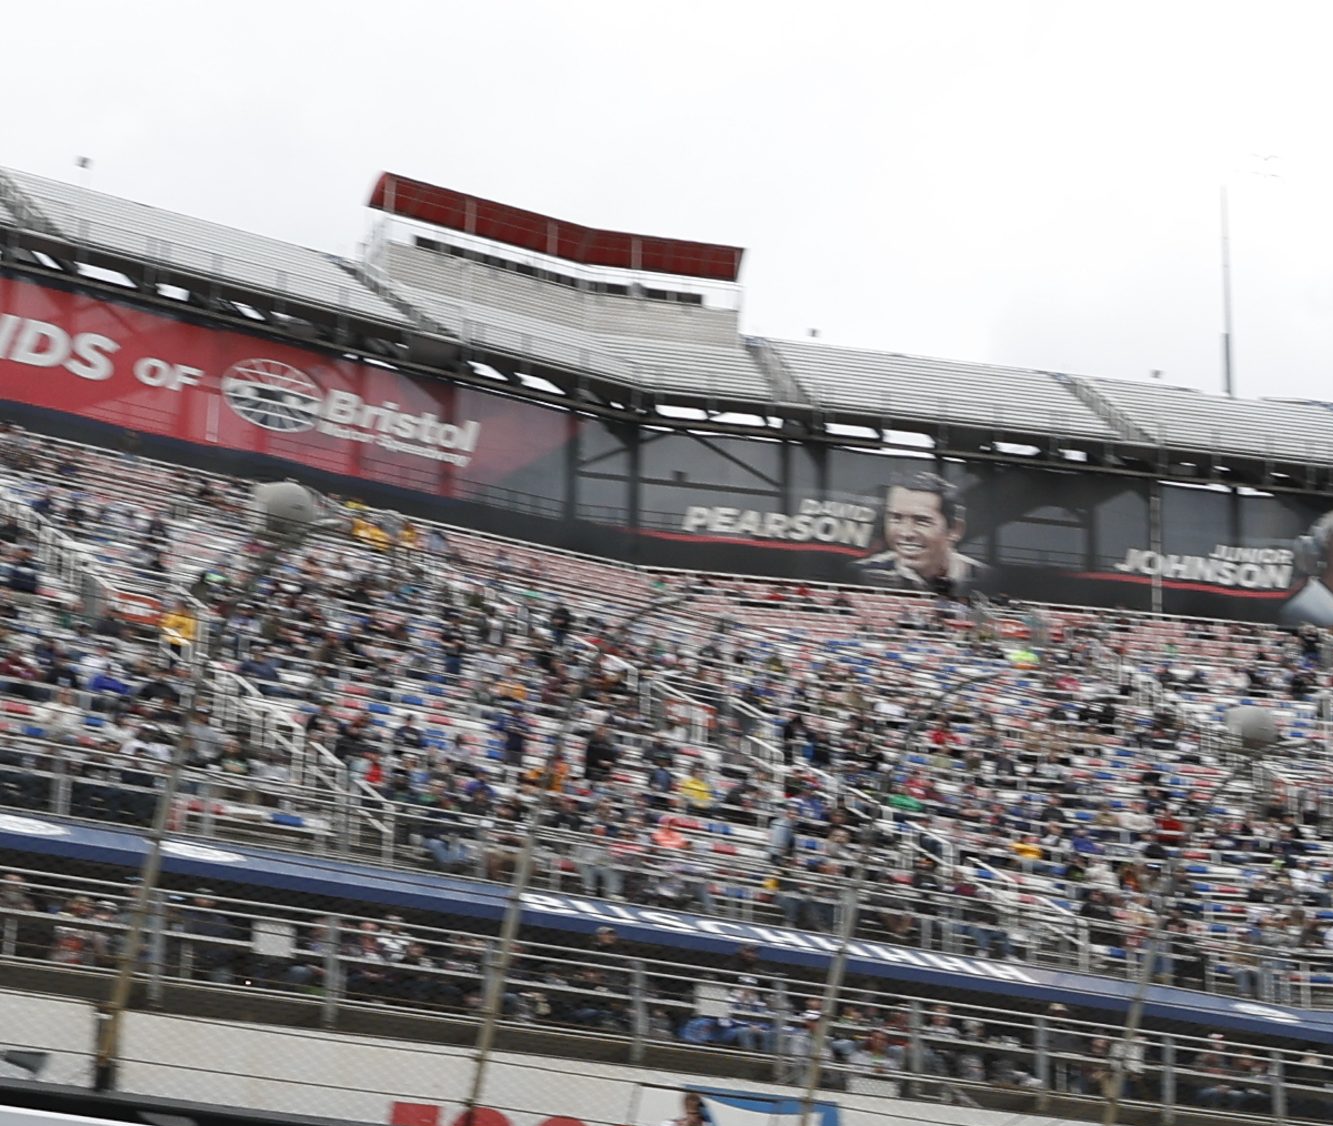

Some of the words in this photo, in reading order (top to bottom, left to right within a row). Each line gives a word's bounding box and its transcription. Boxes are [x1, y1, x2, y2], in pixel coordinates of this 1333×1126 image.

[0, 313, 121, 381] DS
[133, 357, 204, 391] OF
[325, 388, 480, 452] Bristol
[681, 506, 875, 548] PEARSON
[1114, 549, 1294, 589] JOHNSON
